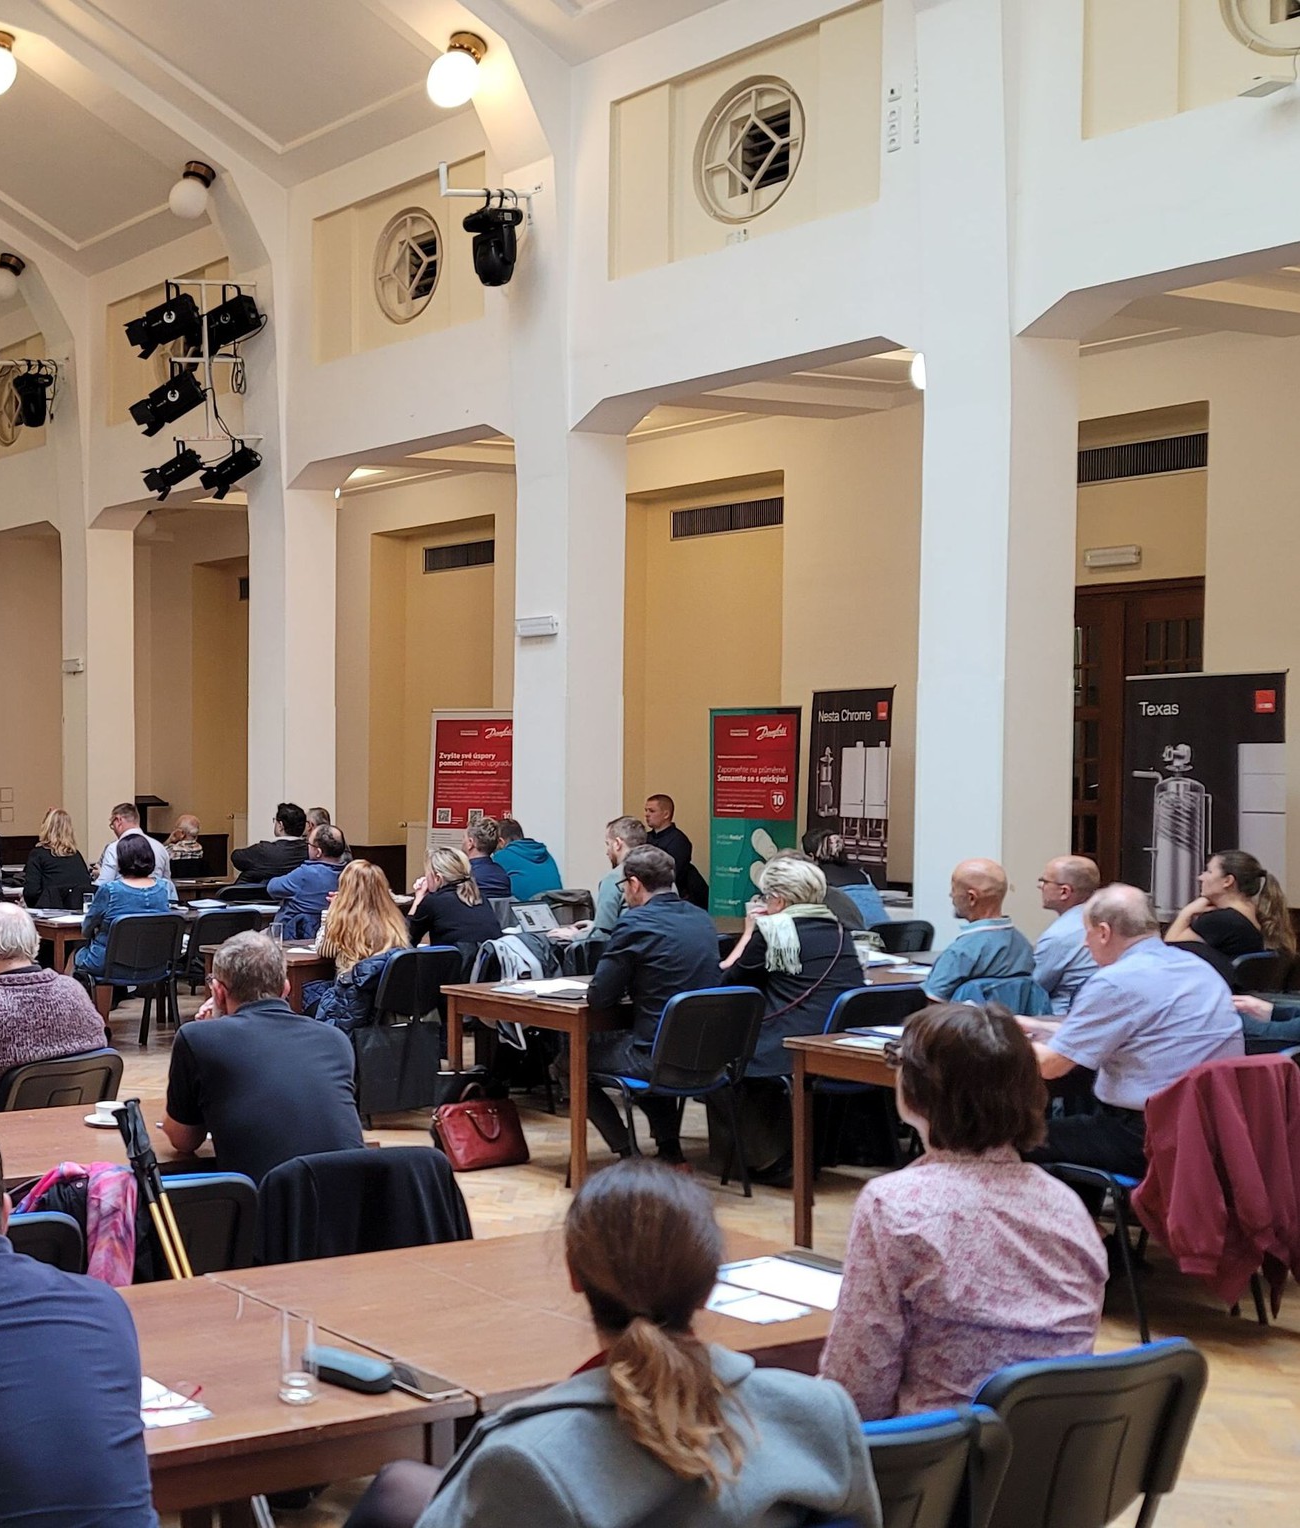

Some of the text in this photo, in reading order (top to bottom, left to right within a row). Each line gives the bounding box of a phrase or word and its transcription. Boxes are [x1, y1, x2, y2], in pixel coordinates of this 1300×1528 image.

[1138, 701, 1180, 716] Texas
[818, 708, 872, 722] Nesta Chrome
[461, 752, 472, 760] své
[473, 752, 497, 761] úspory
[438, 760, 463, 768] pomocí
[717, 773, 747, 782] Seznamte
[760, 774, 789, 784] epickými
[772, 794, 785, 806] 10
